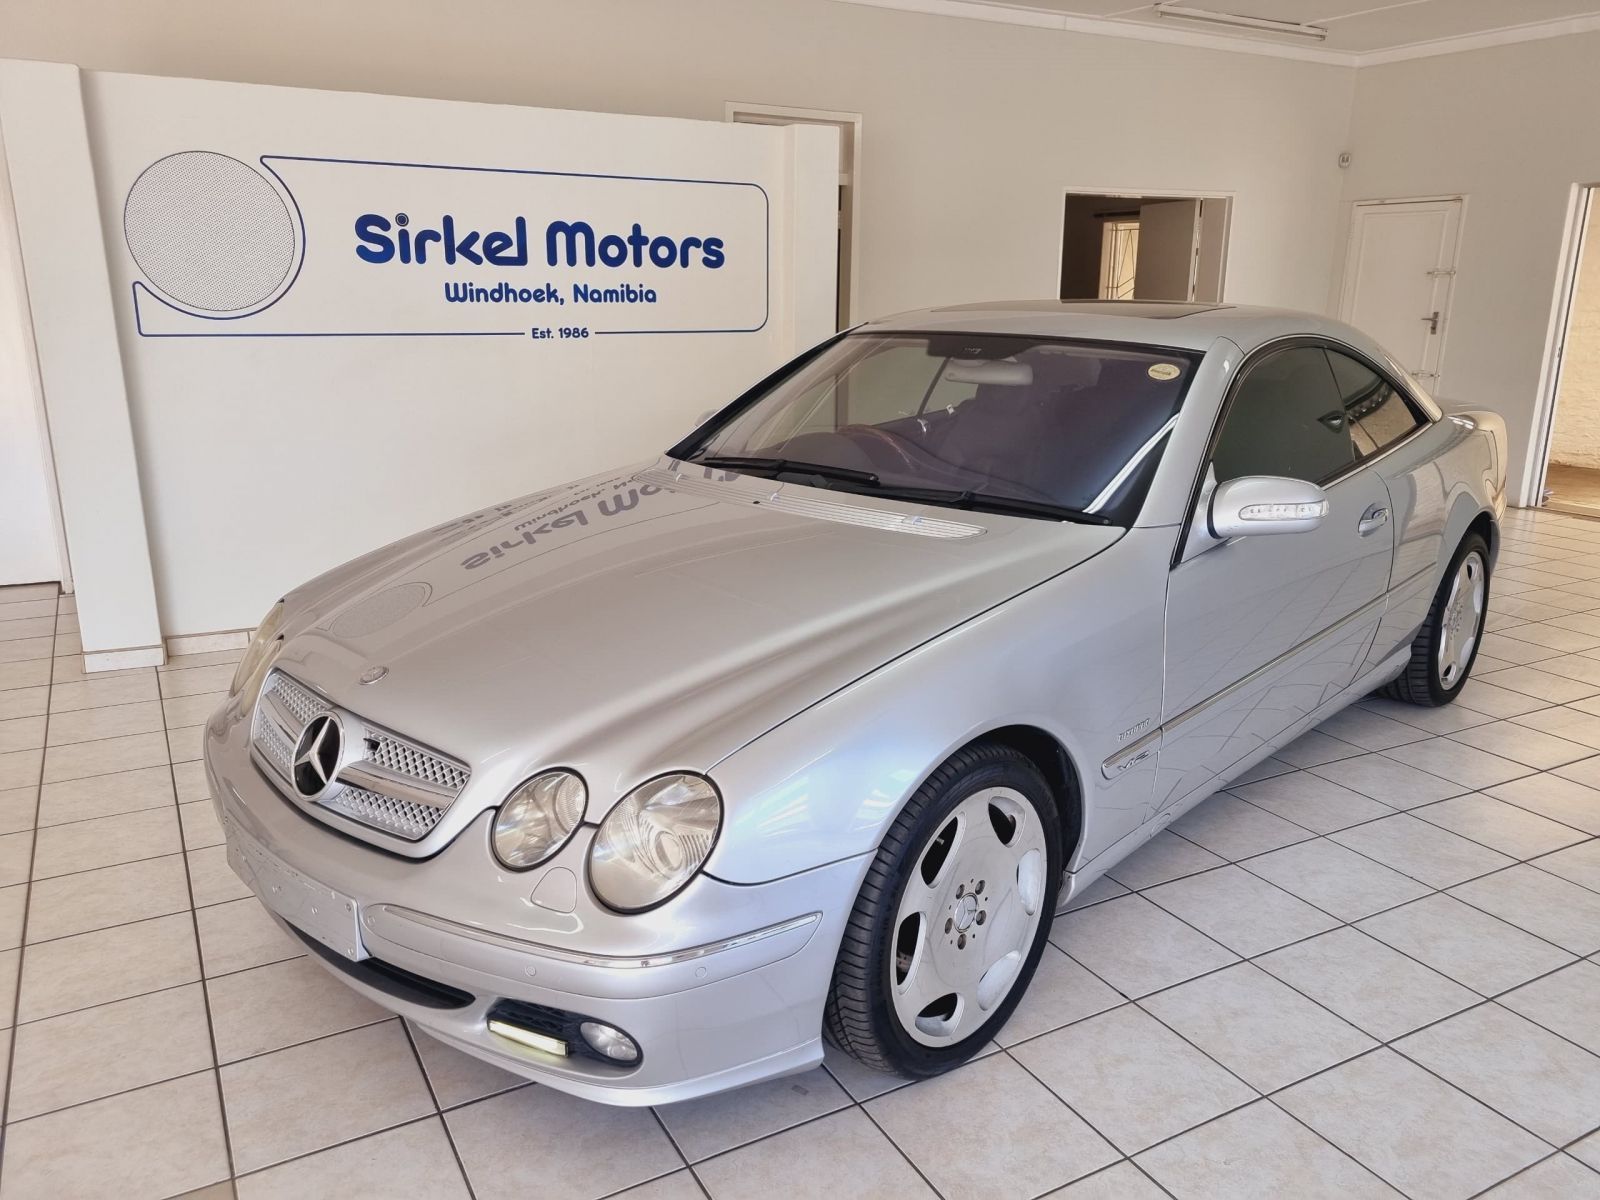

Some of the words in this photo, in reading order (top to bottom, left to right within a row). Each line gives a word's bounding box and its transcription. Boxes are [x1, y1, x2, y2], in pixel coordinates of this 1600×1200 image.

[354, 212, 529, 267] Sirkel
[545, 220, 726, 269] Motors
[444, 281, 565, 306] Windhoek,
[572, 283, 657, 304] Namibia
[531, 327, 554, 339] Est.
[558, 327, 589, 339] 1986
